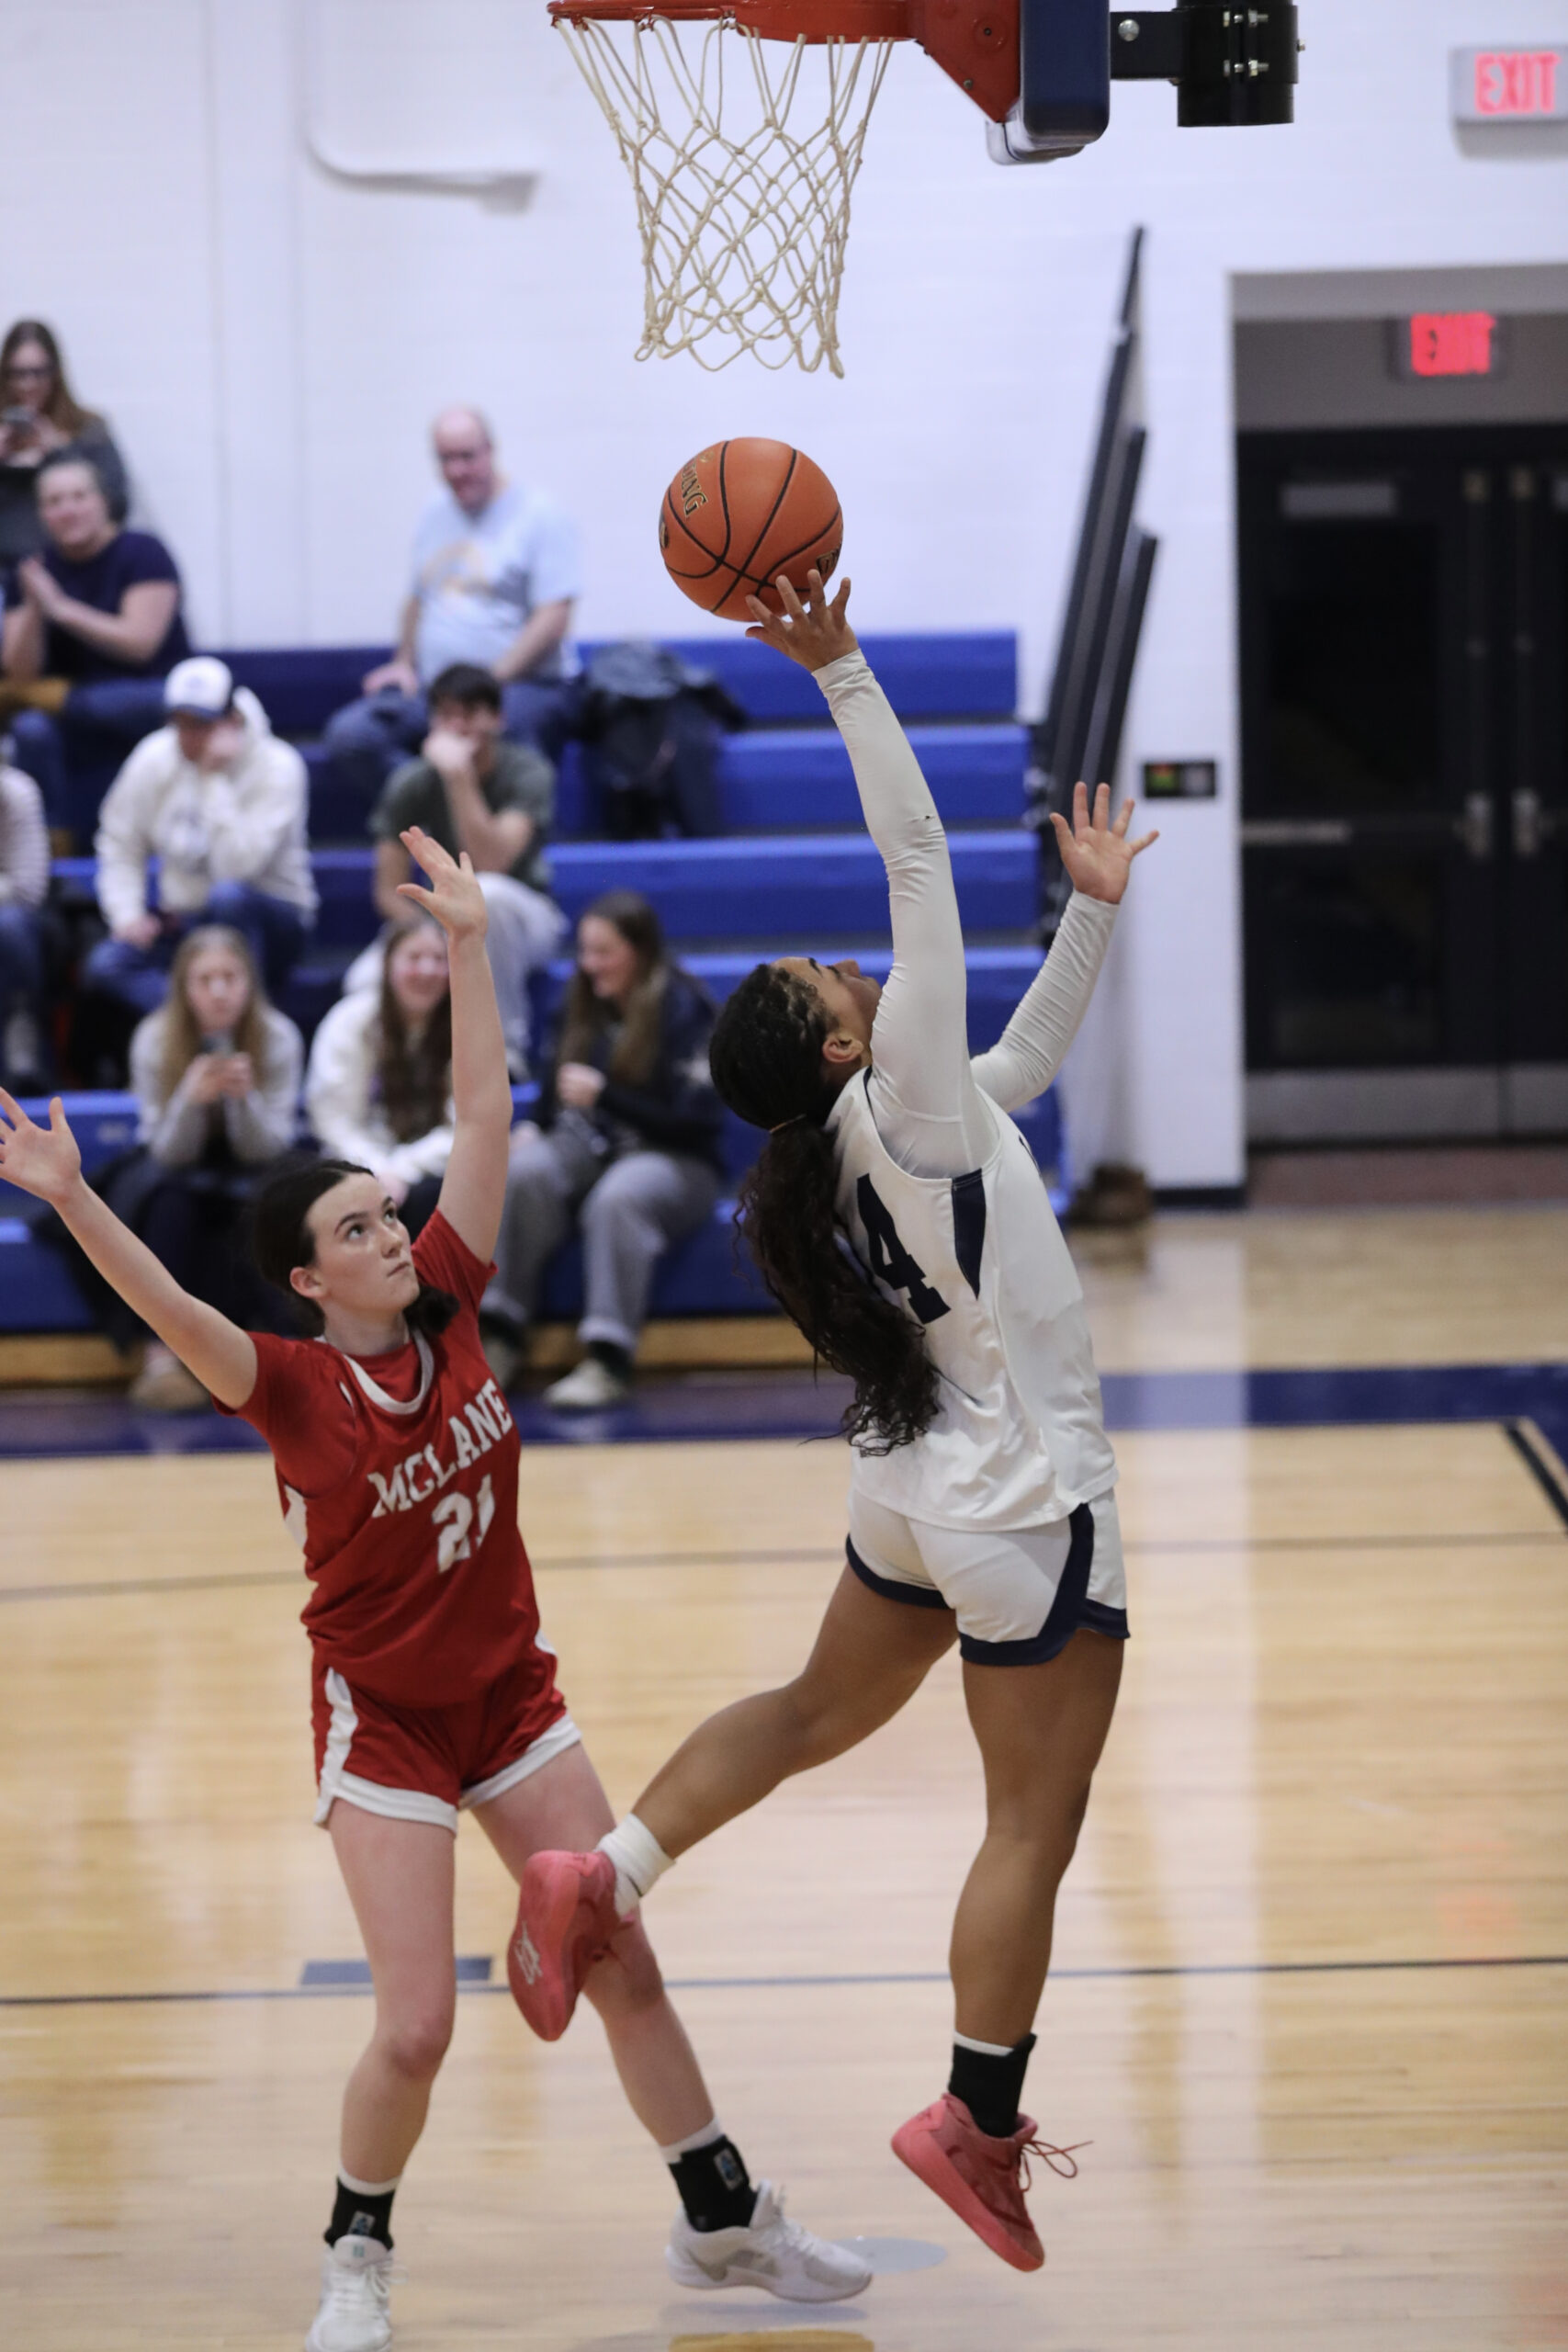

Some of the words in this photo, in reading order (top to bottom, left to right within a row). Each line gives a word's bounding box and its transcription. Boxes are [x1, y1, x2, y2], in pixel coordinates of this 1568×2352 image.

[1474, 52, 1561, 114] EXIT
[367, 1378, 513, 1518] MCLANE
[432, 1473, 496, 1574] 21
